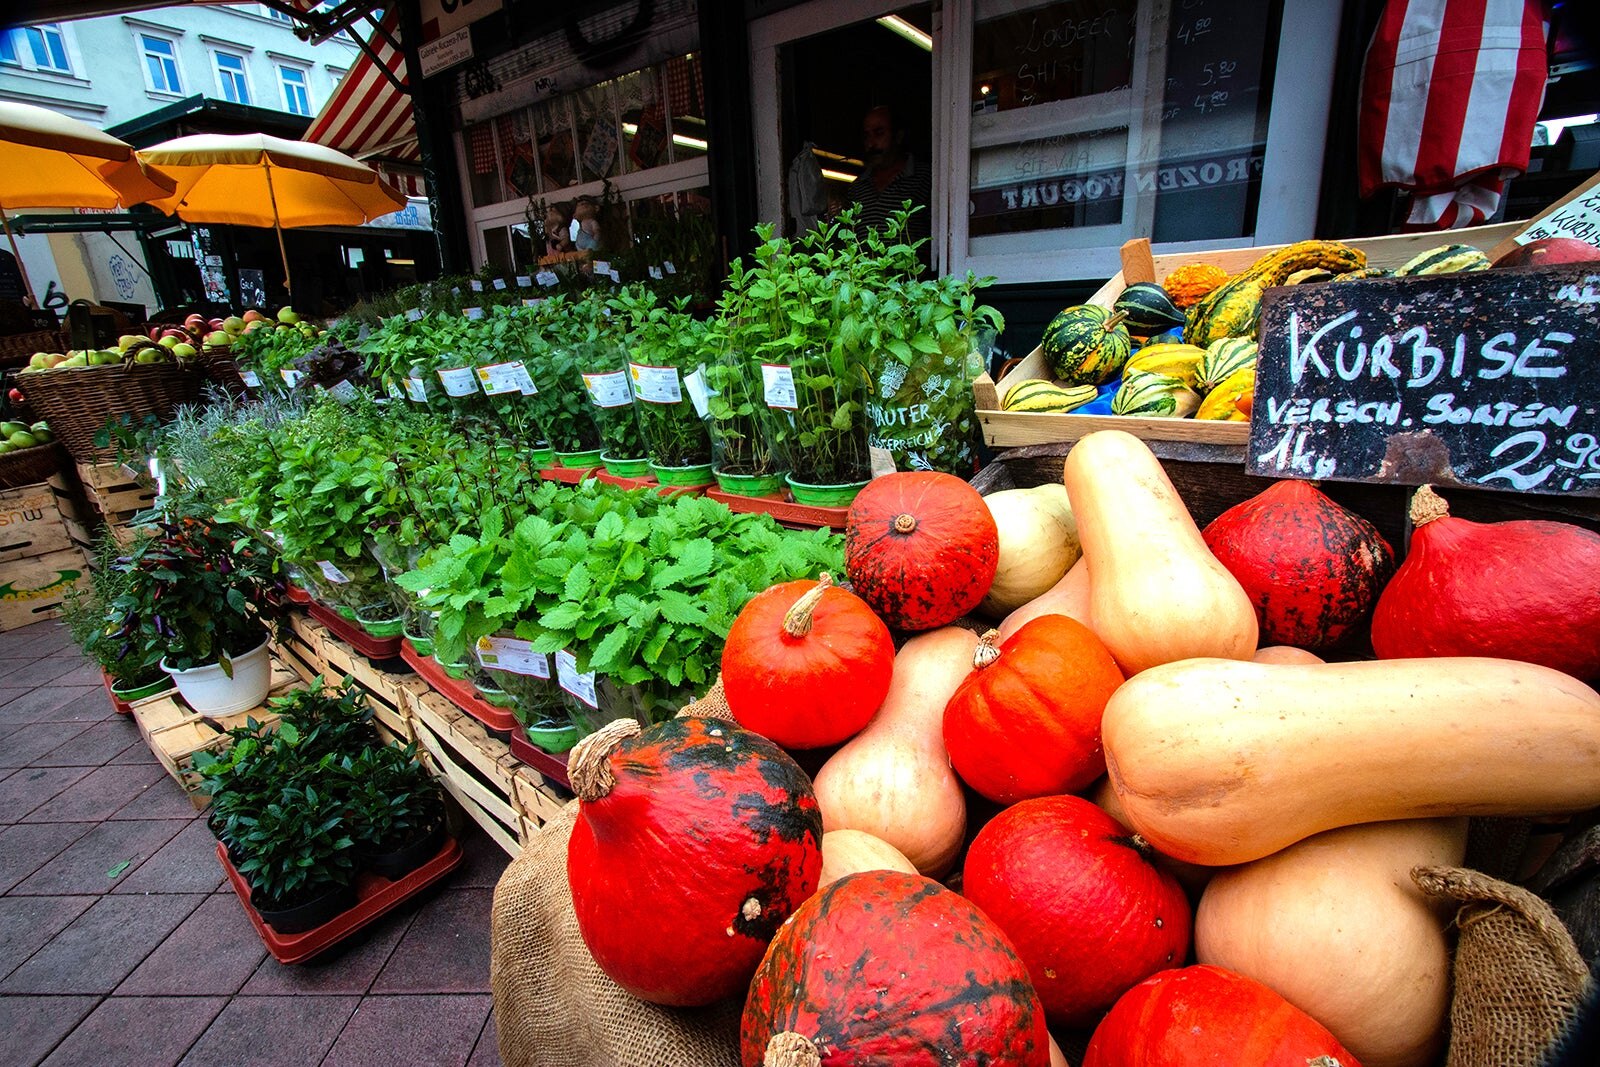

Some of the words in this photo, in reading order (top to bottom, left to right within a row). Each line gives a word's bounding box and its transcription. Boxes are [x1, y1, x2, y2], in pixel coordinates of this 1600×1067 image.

[1288, 308, 1576, 389] KÜRBISE
[1267, 397, 1413, 429] VERSCH.
[1422, 392, 1578, 428] SORTEN
